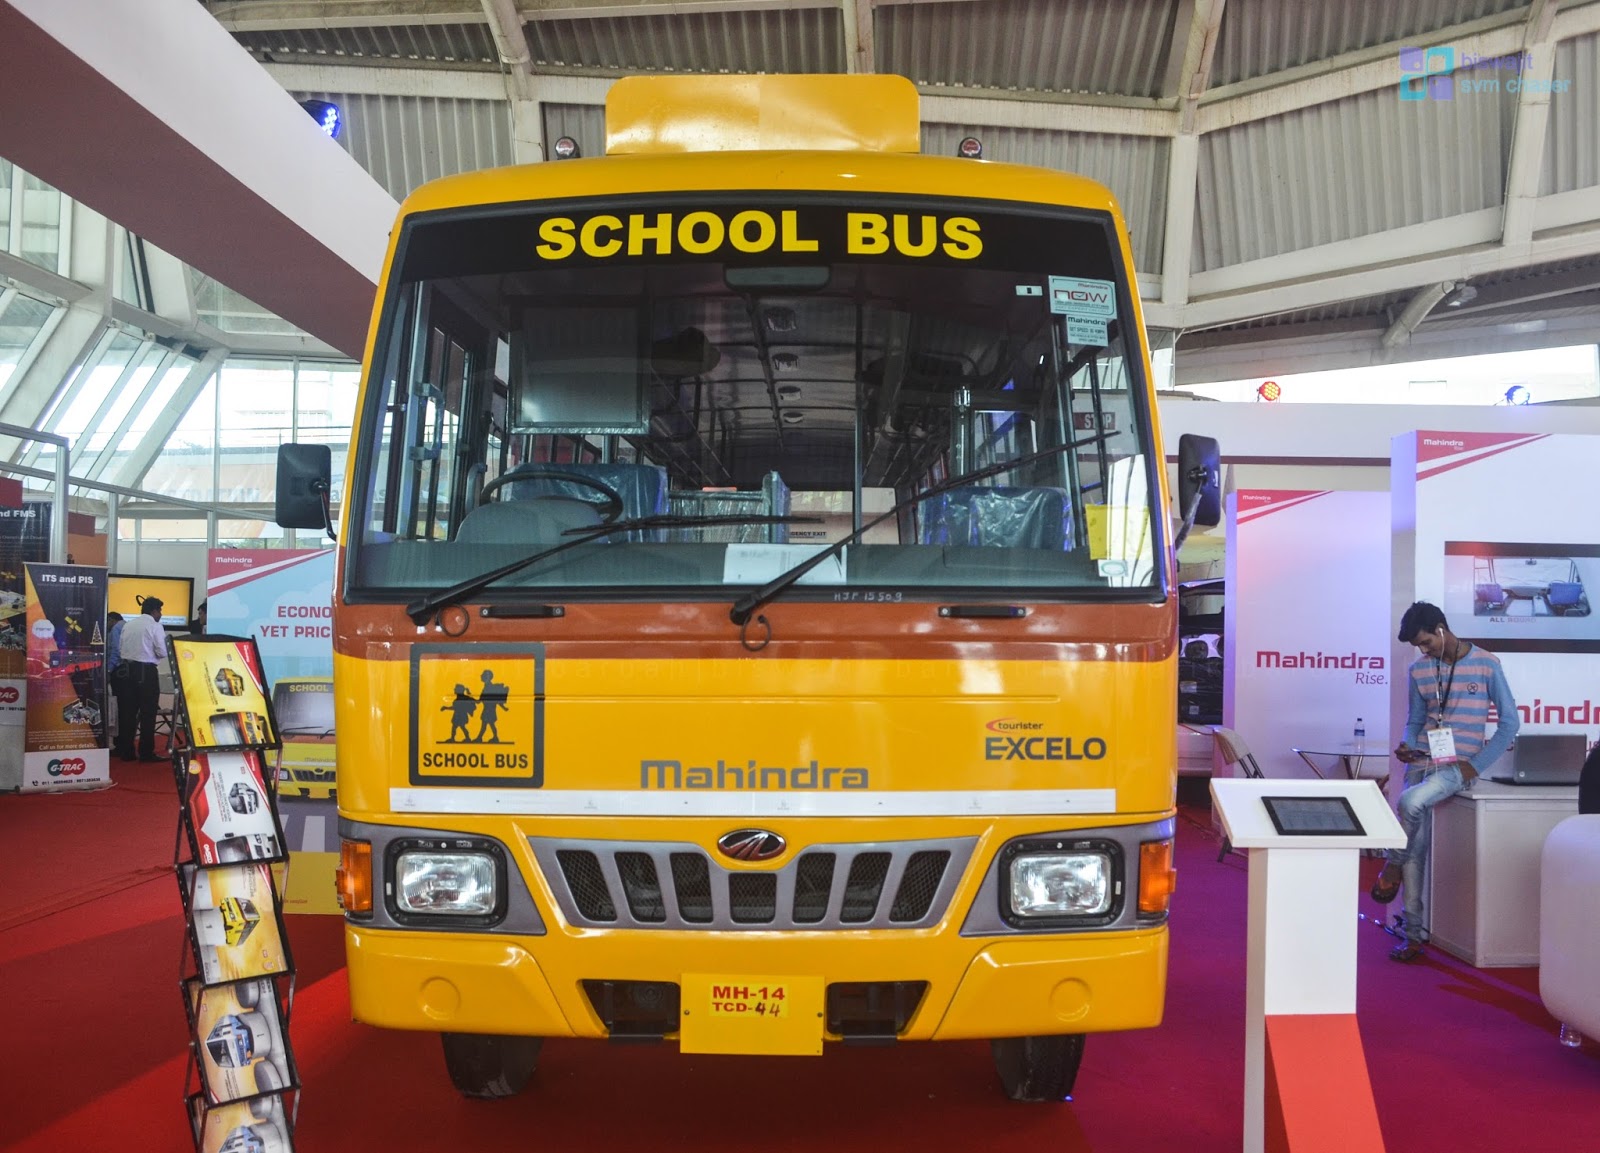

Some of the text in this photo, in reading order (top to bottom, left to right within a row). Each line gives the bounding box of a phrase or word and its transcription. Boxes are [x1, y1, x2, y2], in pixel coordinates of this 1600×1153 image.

[536, 210, 983, 260] SCHOOL BUS
[1067, 316, 1106, 326] Mahindra
[1084, 413, 1112, 429] STP
[1423, 438, 1464, 447] Mahindra
[13, 510, 36, 518] FMS
[215, 556, 252, 564] Mahindra
[41, 574, 94, 584] ITS and PIS
[277, 605, 332, 619] ECONO
[260, 625, 331, 638] YET PRIC
[1256, 650, 1385, 669] Mahindra
[1355, 671, 1389, 685] Rise.
[289, 684, 329, 693] SCHOOL
[998, 722, 1044, 730] tourister
[985, 737, 1107, 760] EXCELO
[50, 762, 84, 772] G-TRAC
[422, 752, 529, 769] SCHOOL BUS
[640, 760, 869, 789] Mahindra
[712, 985, 785, 1000] MH-14
[712, 1002, 781, 1017] TCD-44
